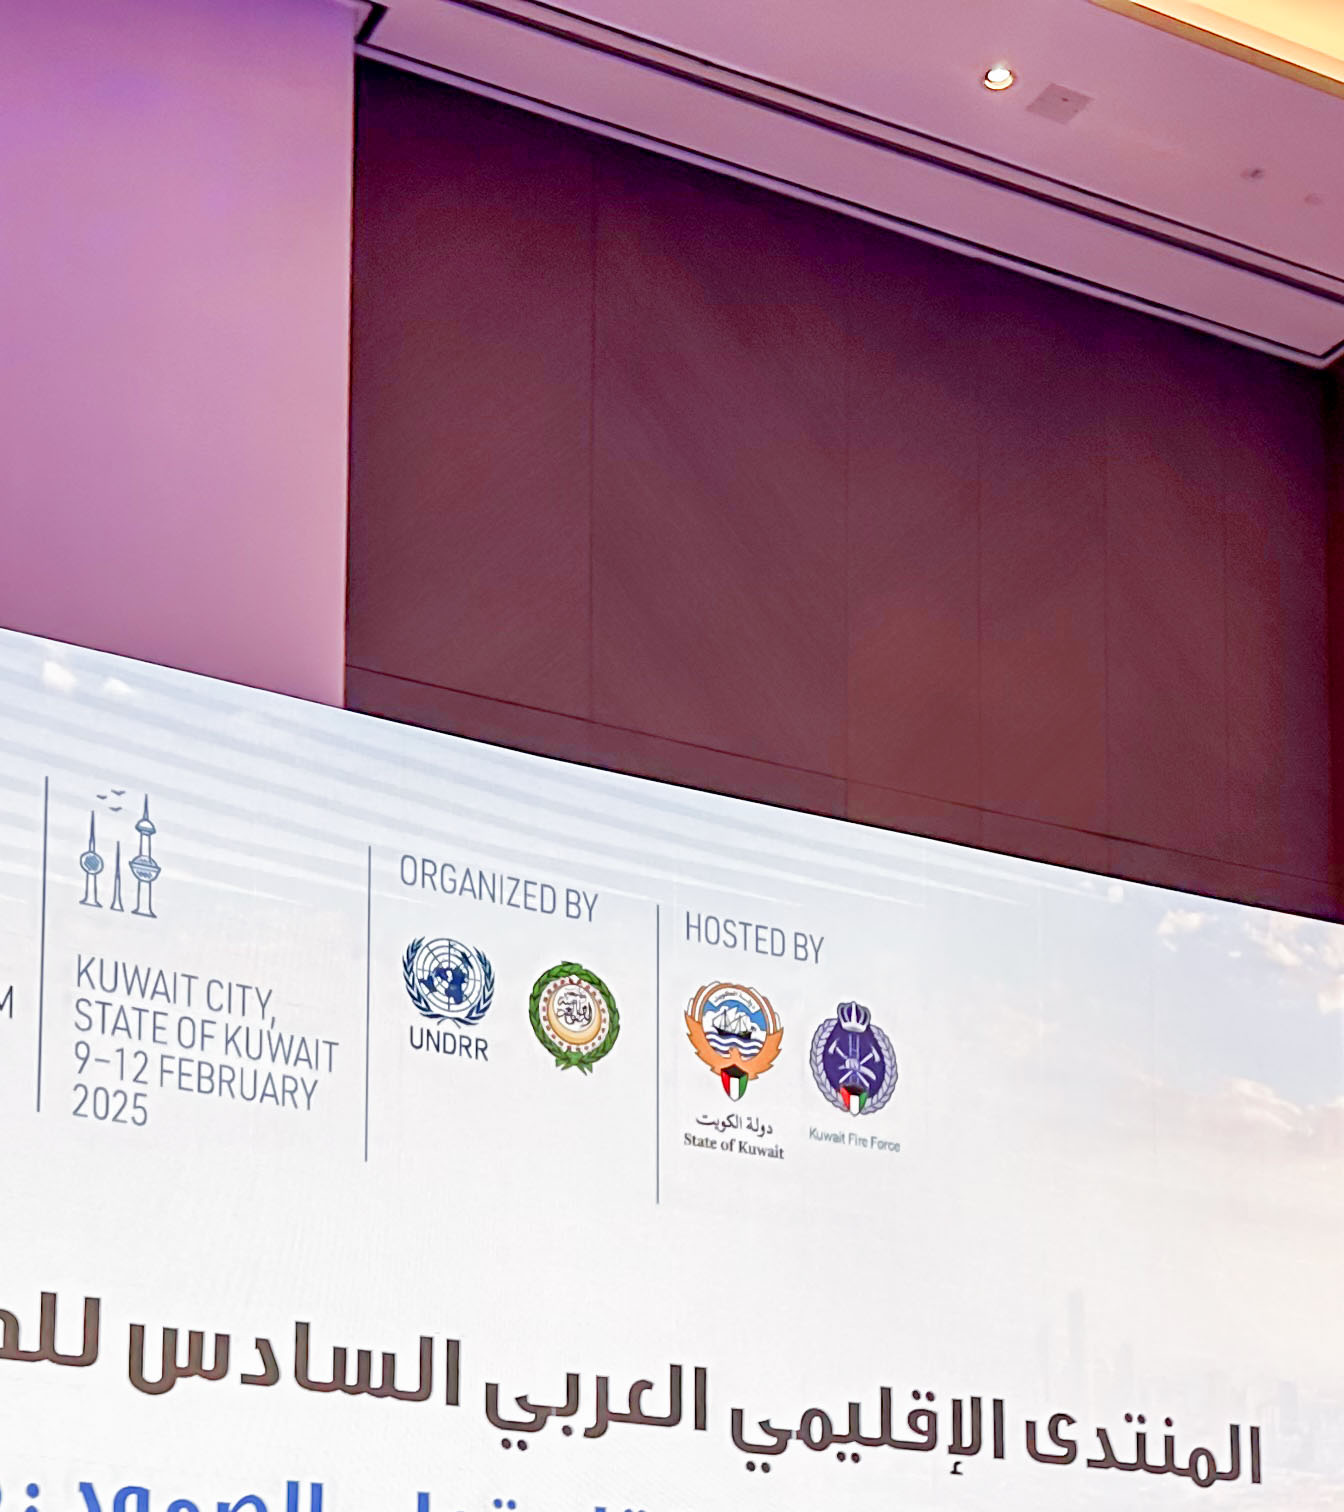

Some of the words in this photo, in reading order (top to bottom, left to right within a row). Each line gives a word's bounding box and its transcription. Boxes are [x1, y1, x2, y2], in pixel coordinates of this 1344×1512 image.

[401, 855, 556, 914] ORGANIZED
[566, 888, 598, 922] BY
[686, 911, 785, 957] HOSTED
[794, 932, 824, 964] BY
[77, 954, 198, 1007] KUWAIT
[207, 979, 275, 1029] CITY,
[75, 998, 168, 1045] STATE
[178, 1016, 216, 1051] OF
[225, 1023, 339, 1072] KUWAIT
[410, 1025, 488, 1061] UNDRR
[73, 1083, 147, 1126] 2025
[160, 1054, 318, 1110] FEBRUARY
[684, 1133, 717, 1150] State
[720, 1137, 736, 1152] of
[738, 1138, 784, 1159] Kuwait
[696, 1114, 743, 1133] الكويت
[746, 1116, 773, 1138] دولة
[809, 1127, 846, 1145] Kuwait
[848, 1132, 868, 1148] Fire
[870, 1136, 901, 1153] Force
[128, 1321, 461, 1407] السادس
[485, 1363, 707, 1451] العربي
[731, 1386, 1005, 1475] الإقليمي
[1025, 1413, 1262, 1488] المنتدى
